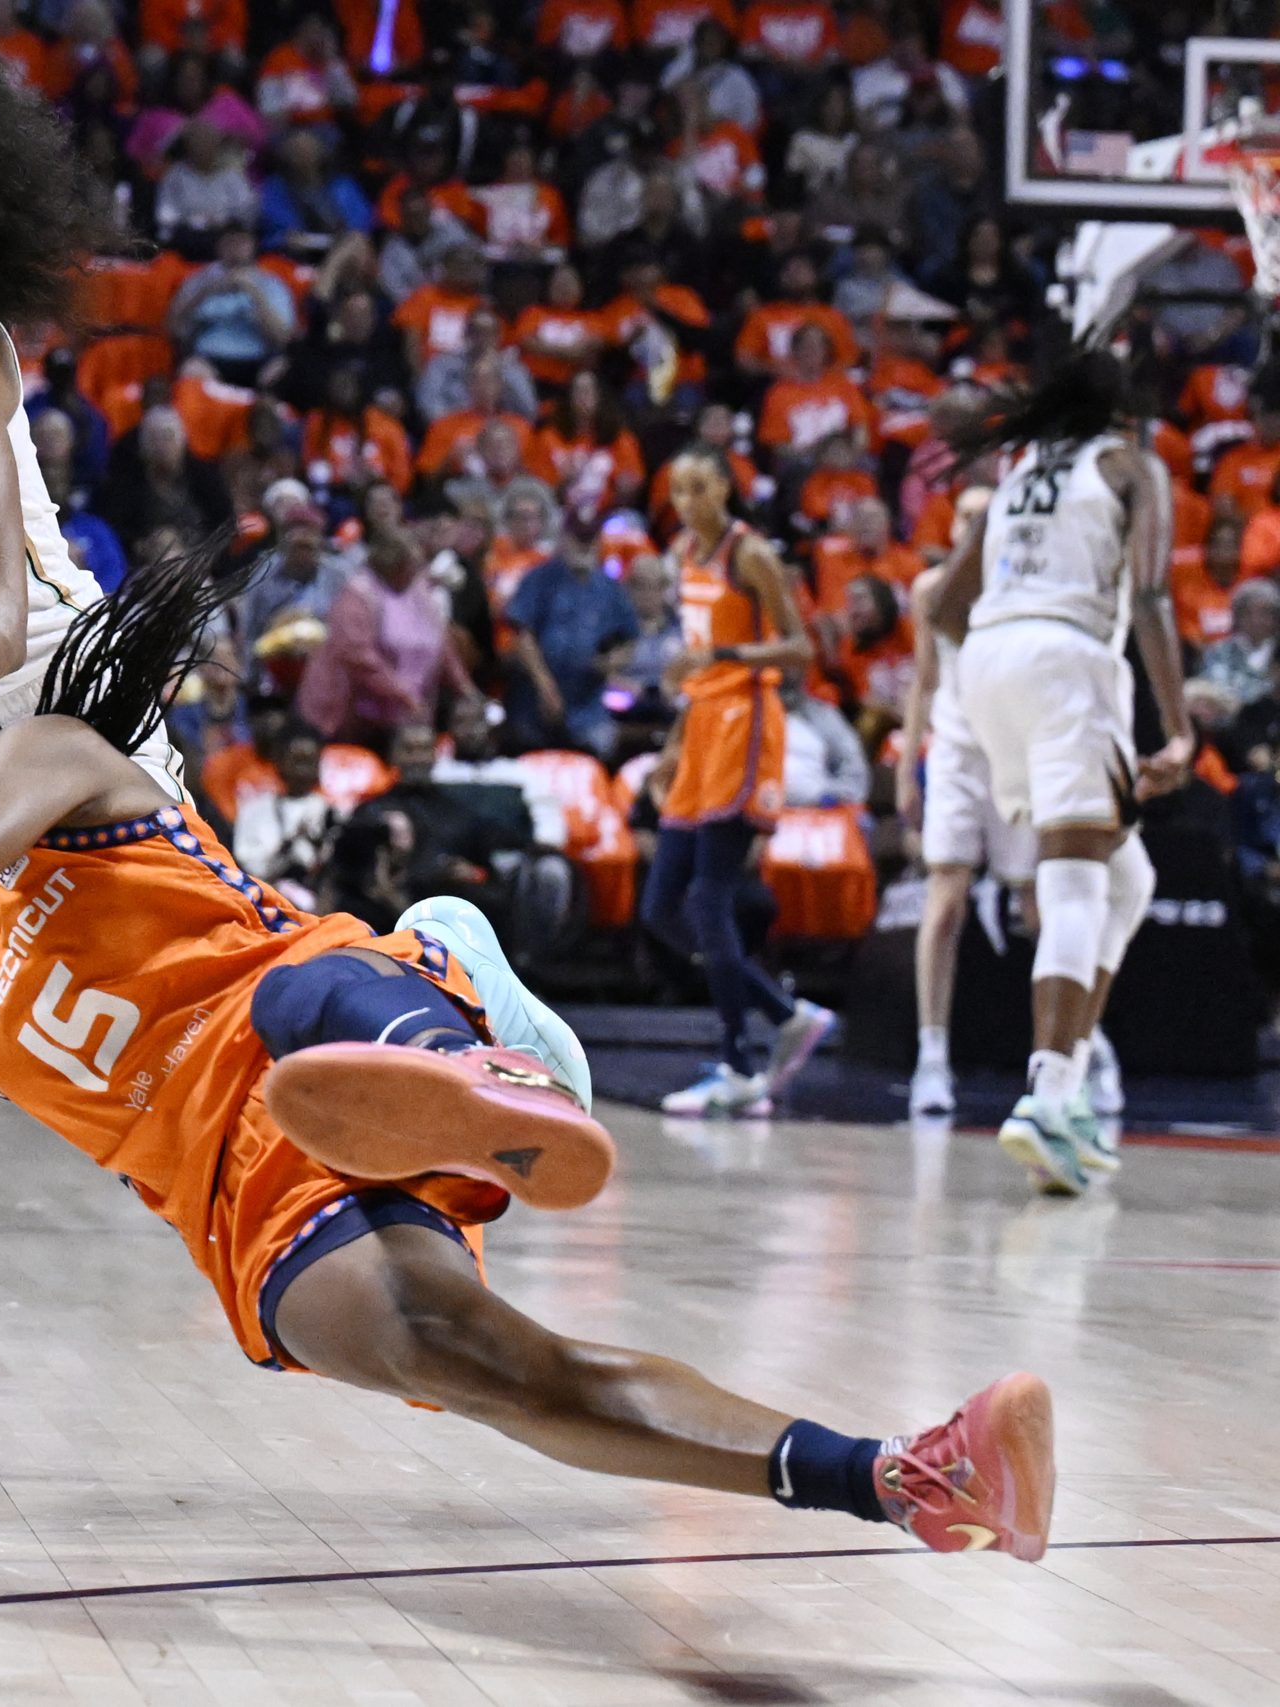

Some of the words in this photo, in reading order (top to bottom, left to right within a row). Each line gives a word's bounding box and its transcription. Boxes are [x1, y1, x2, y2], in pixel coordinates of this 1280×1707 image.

[16, 959, 141, 1093] 15
[124, 1071, 153, 1111] Yale
[160, 1007, 212, 1075] Haven
